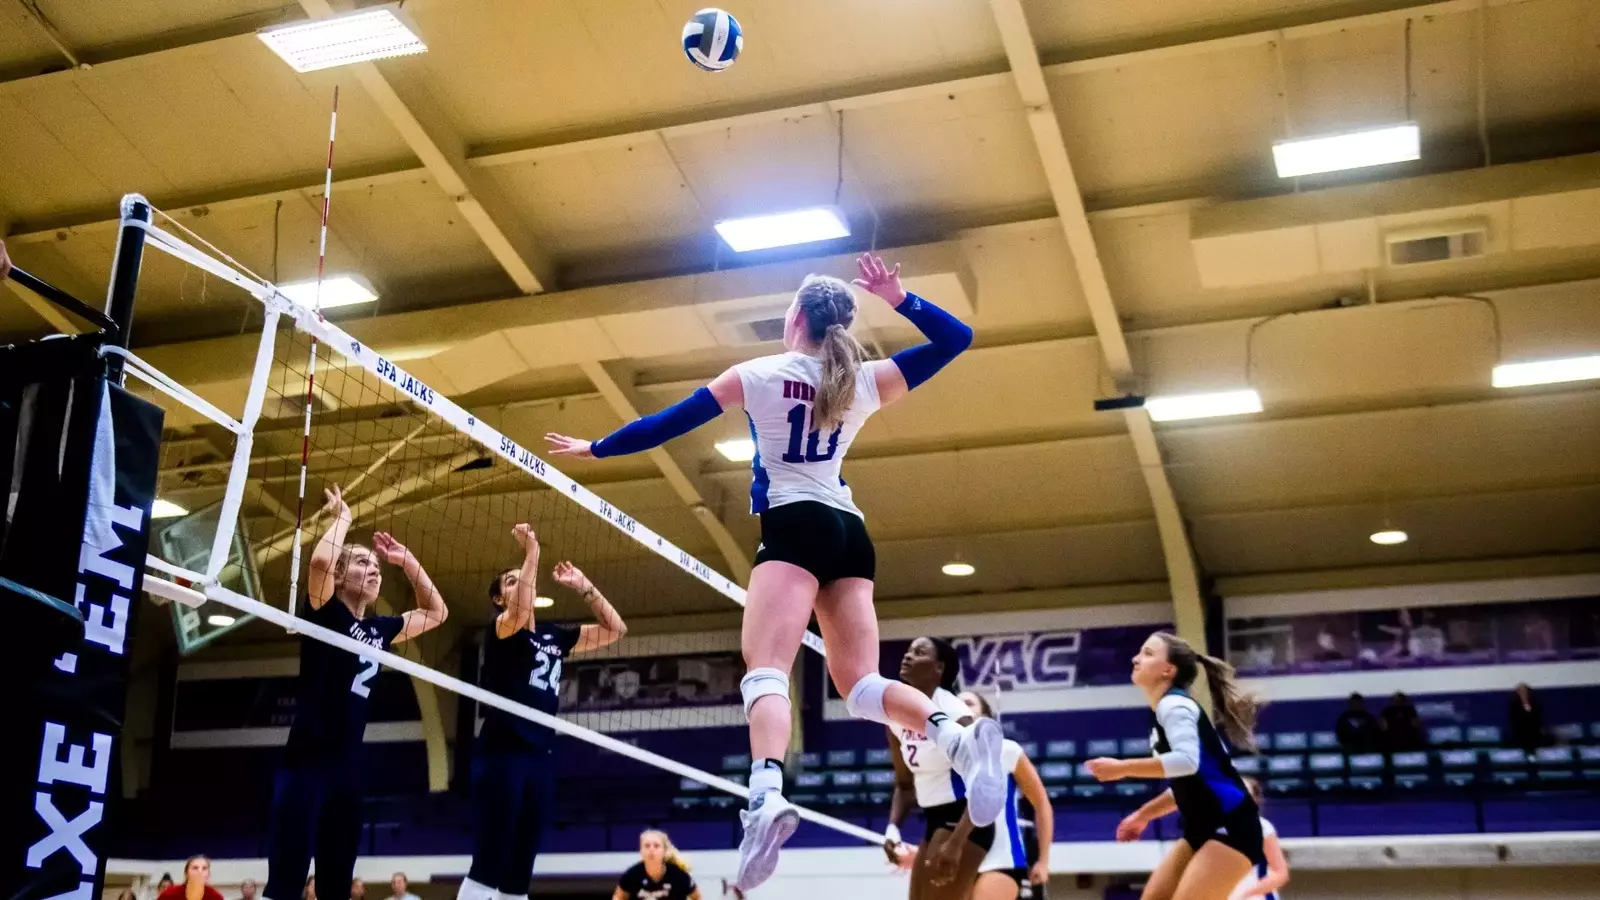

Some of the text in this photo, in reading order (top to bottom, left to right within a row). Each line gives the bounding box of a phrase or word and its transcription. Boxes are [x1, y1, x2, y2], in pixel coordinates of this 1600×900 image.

[376, 357, 434, 405] SFA JACKS
[500, 436, 546, 477] SFA JACKS
[599, 500, 636, 534] SFA JACKS
[351, 654, 379, 699] 2
[528, 651, 562, 696] 24
[907, 744, 920, 767] 2
